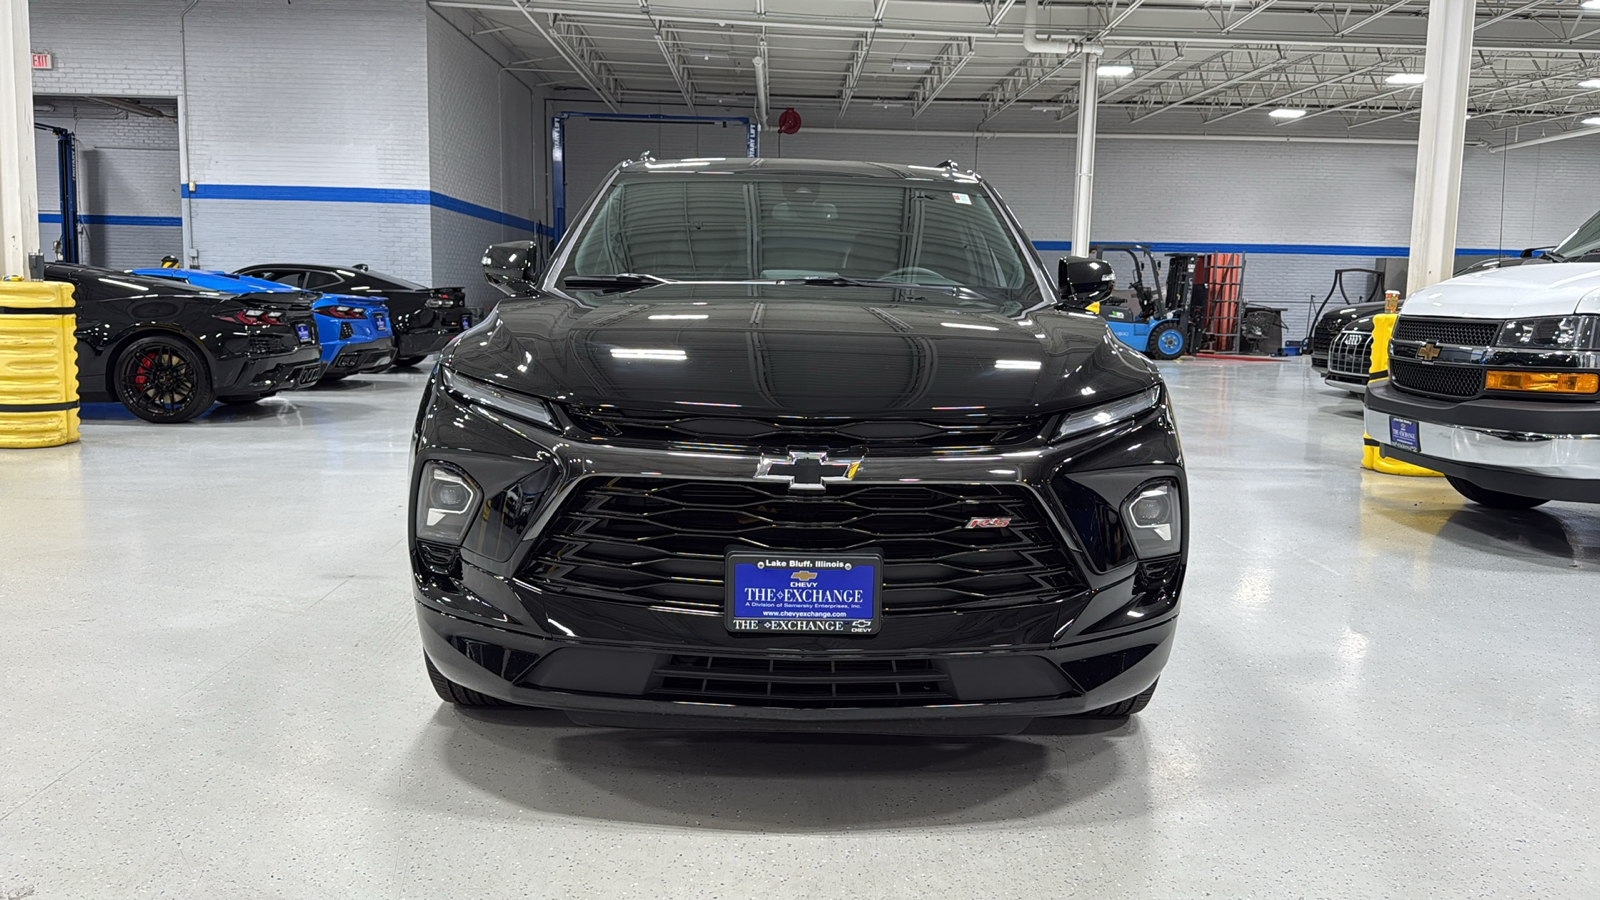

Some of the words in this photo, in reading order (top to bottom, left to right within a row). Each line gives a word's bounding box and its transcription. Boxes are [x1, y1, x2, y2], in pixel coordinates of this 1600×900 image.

[32, 54, 48, 67] EXIT
[966, 517, 1011, 528] RS
[765, 559, 787, 567] Lake
[789, 560, 813, 568] Bluff,
[815, 560, 845, 568] Illinois
[744, 587, 776, 601] THE
[784, 588, 864, 604] EXCHANGE
[762, 610, 847, 618] www.chevyexchange.com
[733, 619, 759, 630] THE
[770, 620, 844, 631] EXCHANGE
